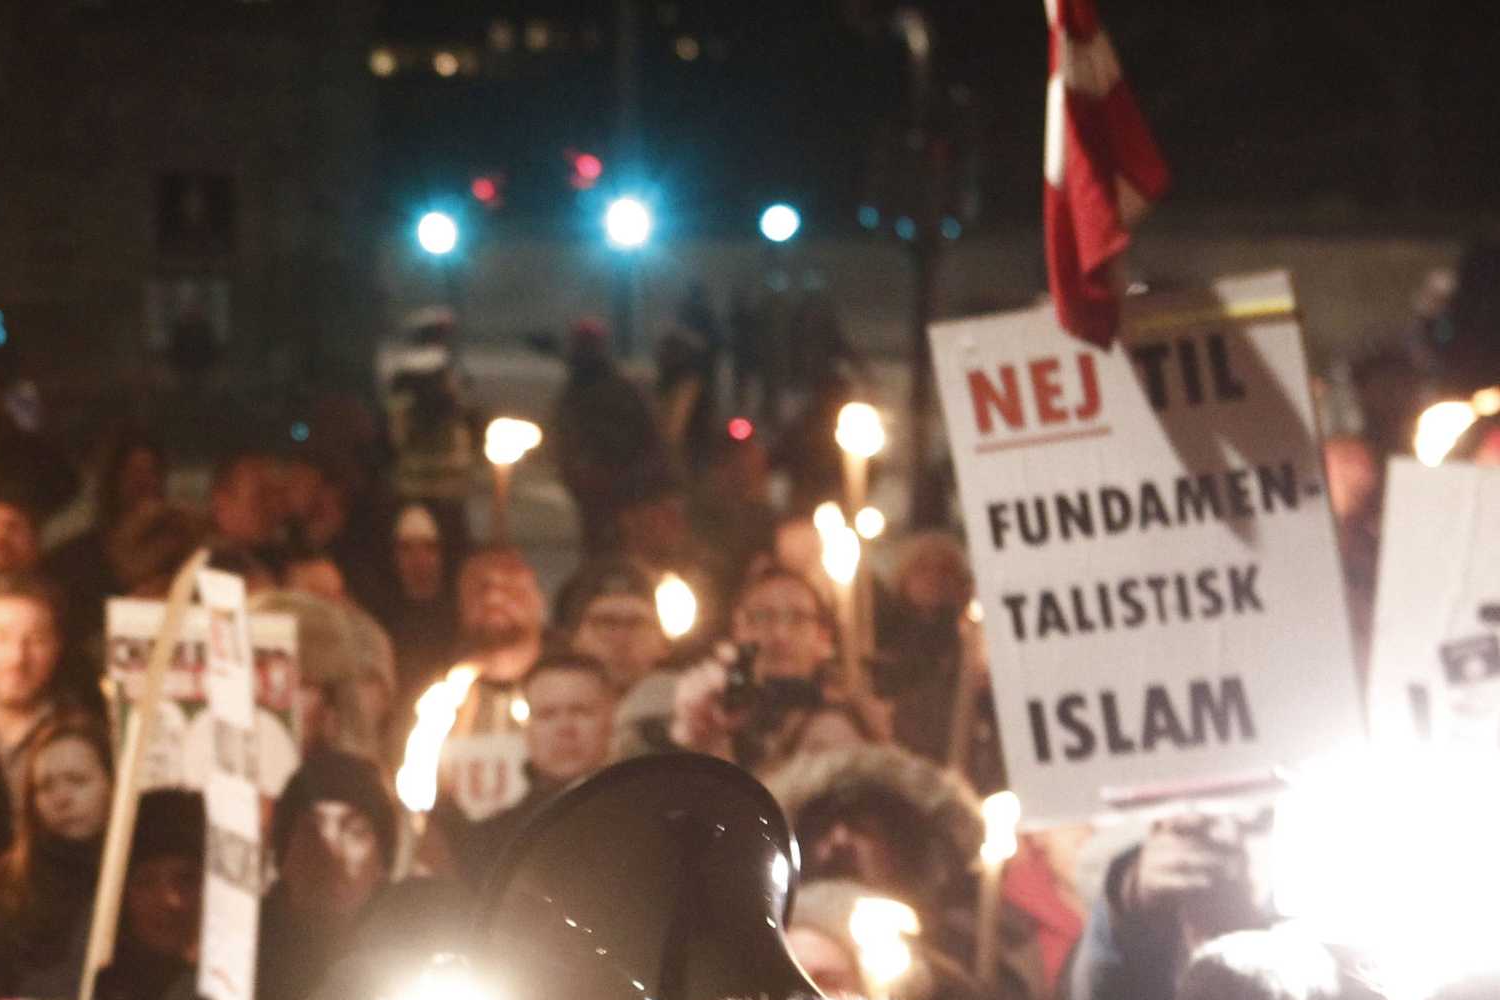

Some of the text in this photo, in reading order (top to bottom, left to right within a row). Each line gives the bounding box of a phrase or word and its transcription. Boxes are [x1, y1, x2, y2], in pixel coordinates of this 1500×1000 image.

[967, 333, 1246, 435] NEJ TIL
[987, 464, 1326, 551] FUNDAMEN-
[1002, 564, 1265, 642] TALISTISK
[1027, 676, 1258, 763] ISLAM
